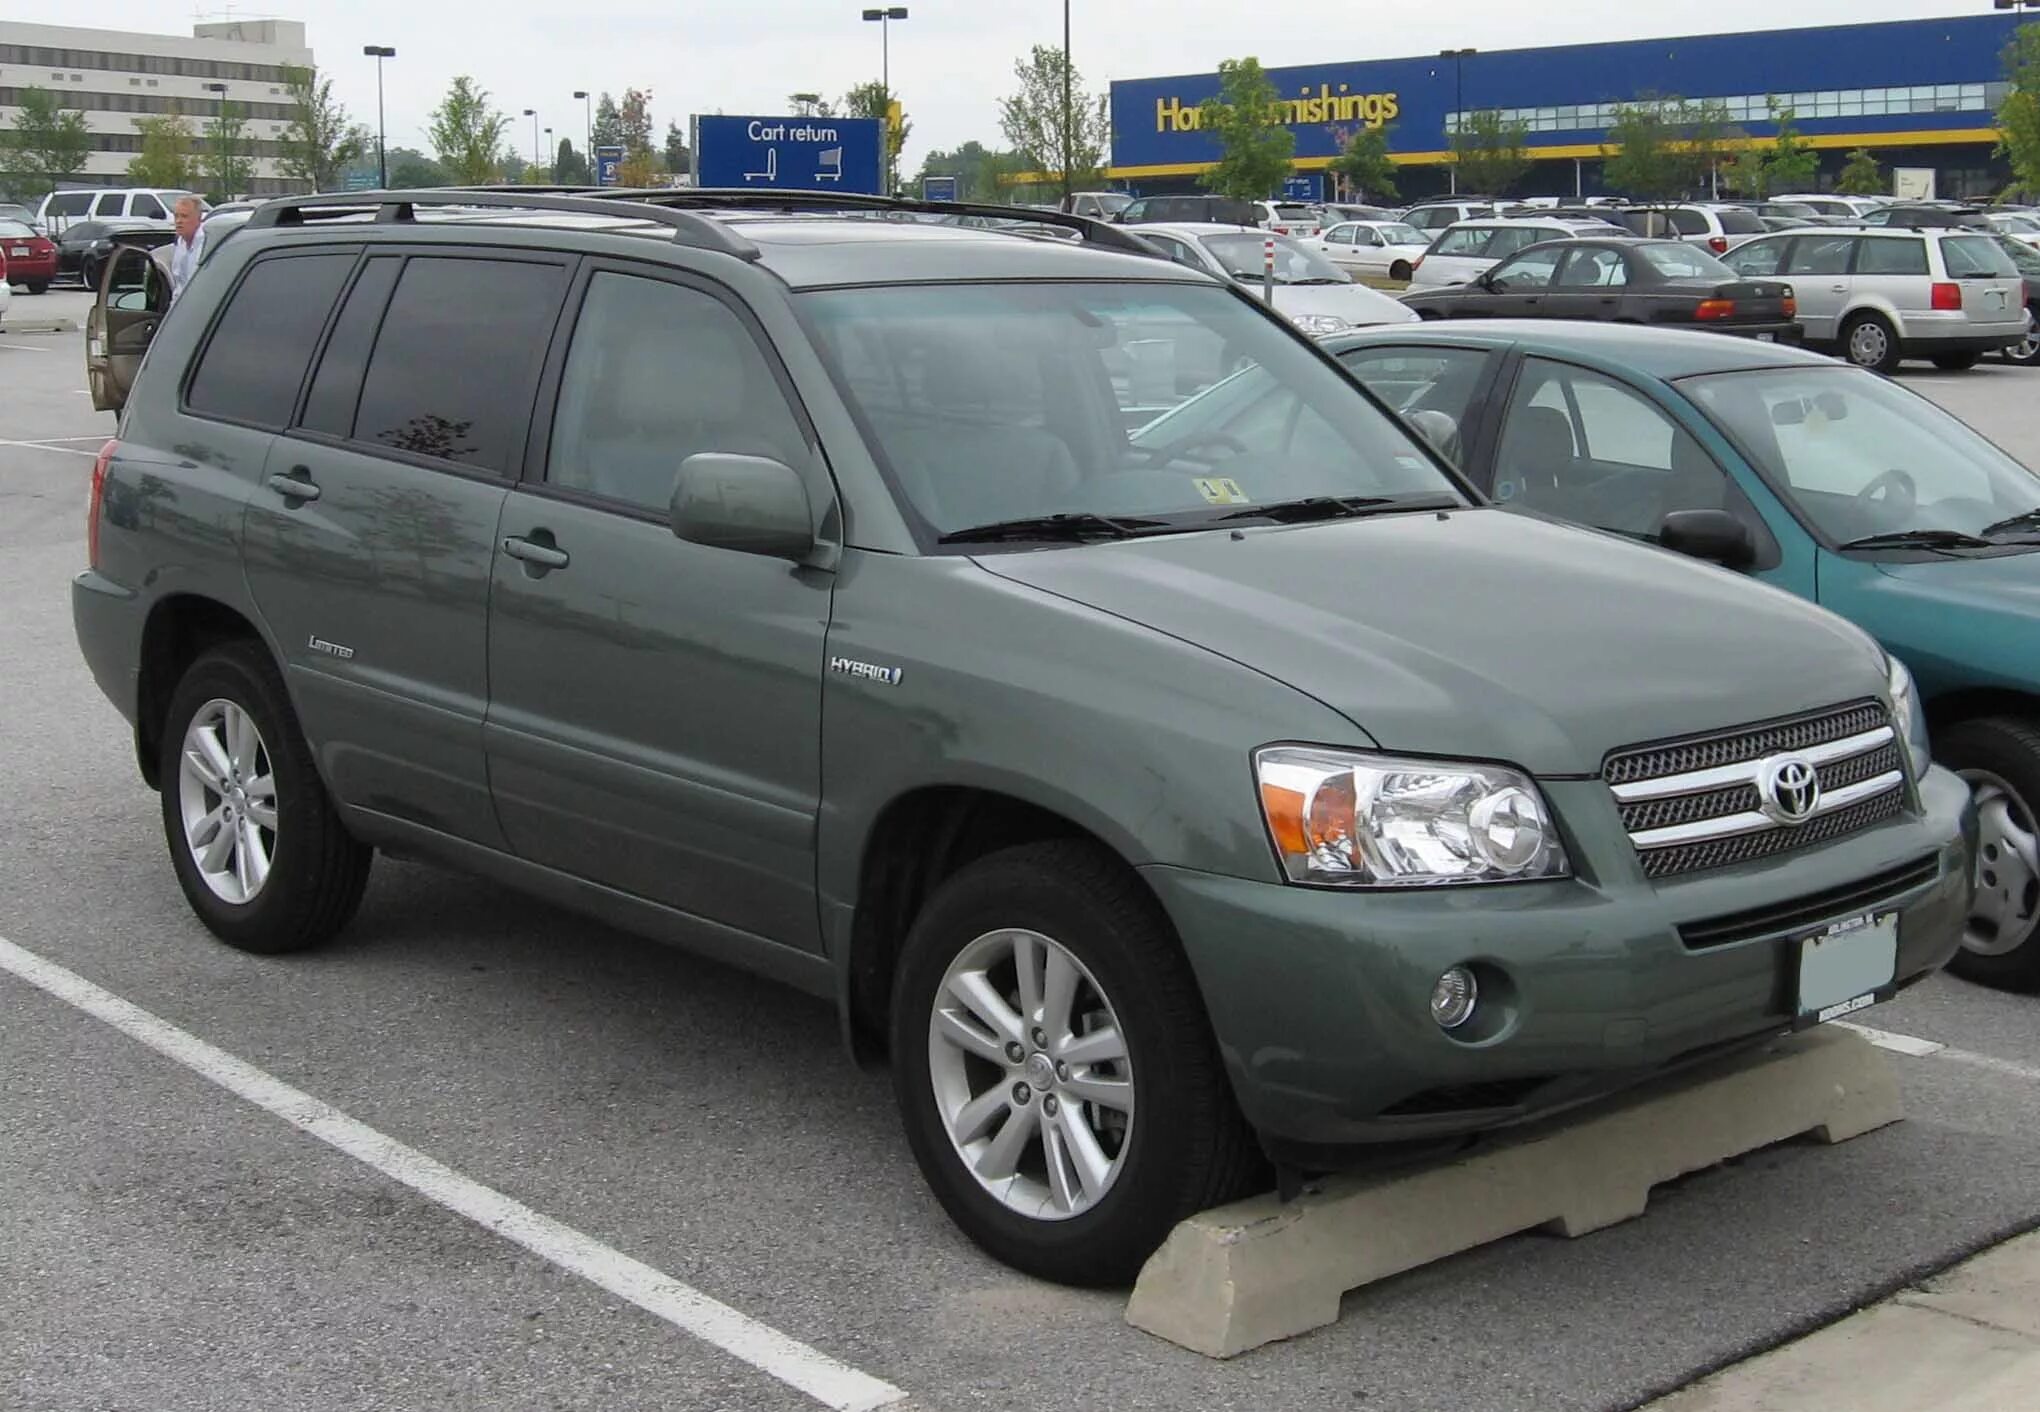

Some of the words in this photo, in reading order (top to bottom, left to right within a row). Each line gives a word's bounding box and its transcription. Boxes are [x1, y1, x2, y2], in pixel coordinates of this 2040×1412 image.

[748, 120, 784, 141] Cart
[789, 124, 837, 142] return
[831, 656, 890, 683] HYBRID
